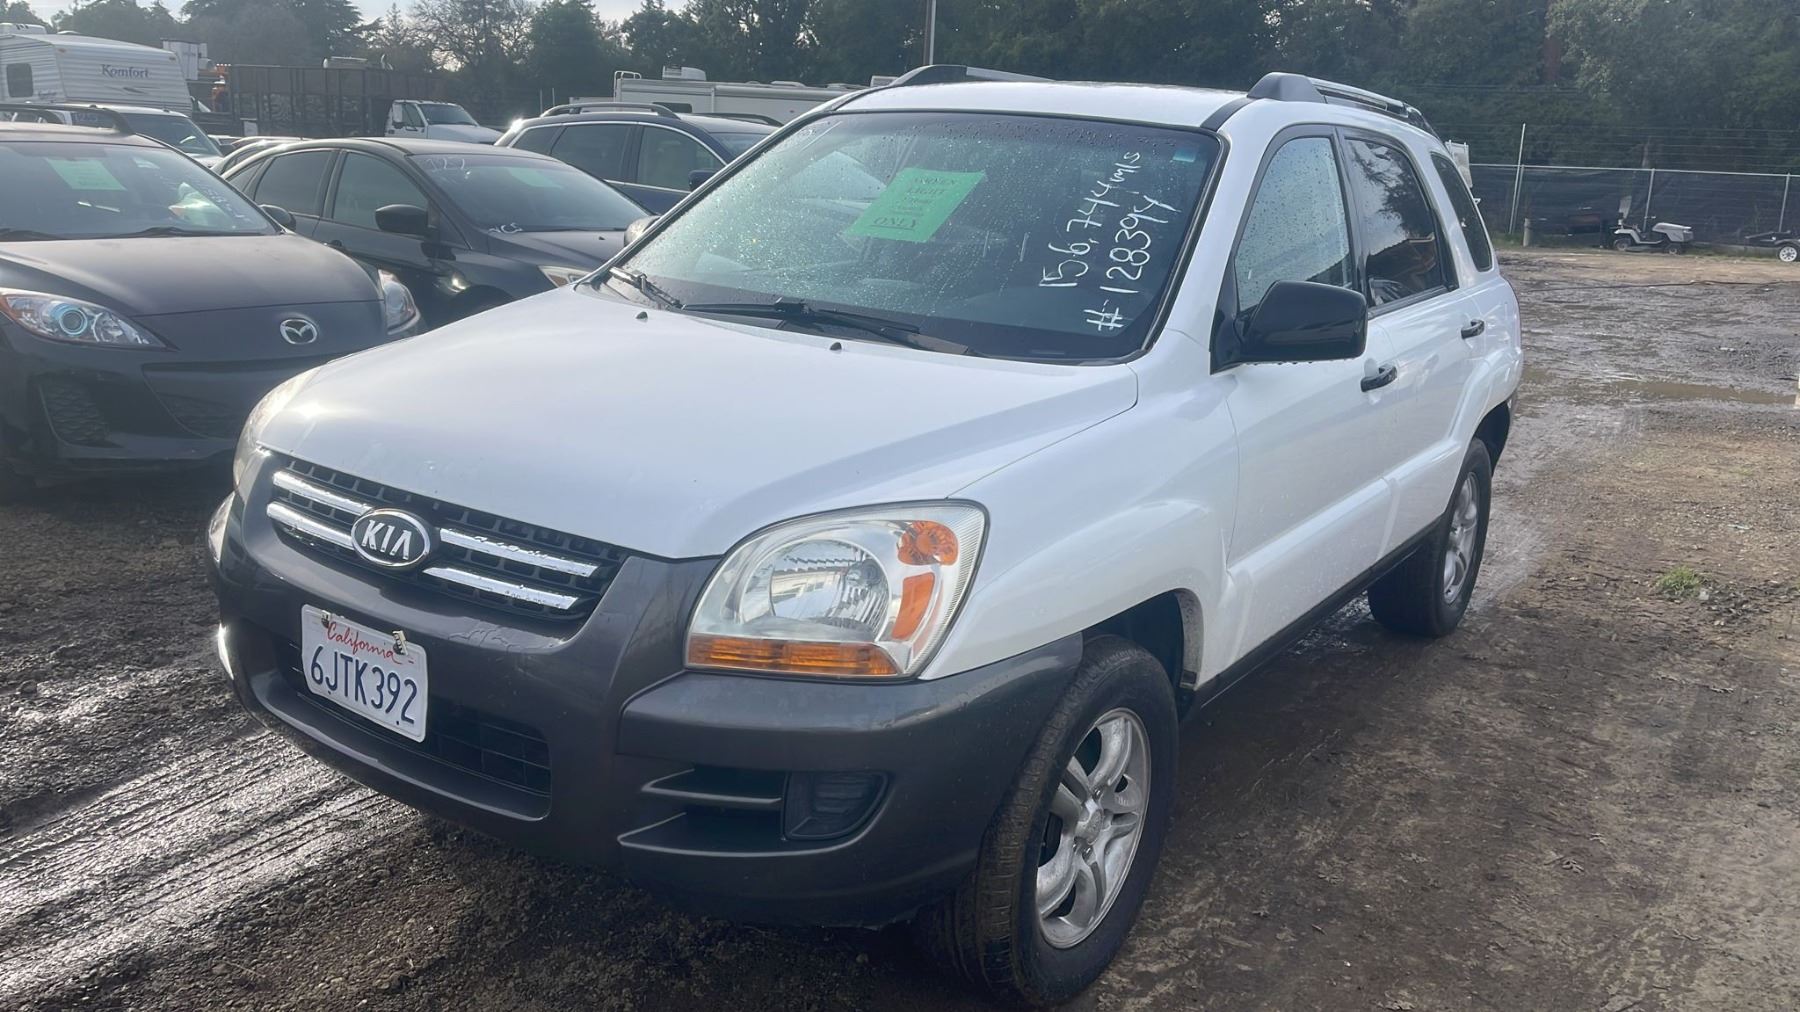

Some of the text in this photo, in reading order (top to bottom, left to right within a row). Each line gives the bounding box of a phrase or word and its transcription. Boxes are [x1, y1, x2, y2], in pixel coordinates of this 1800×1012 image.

[101, 63, 149, 79] Komfort
[361, 519, 412, 560] KIA
[327, 621, 403, 665] California
[311, 645, 418, 724] 6JTK392
